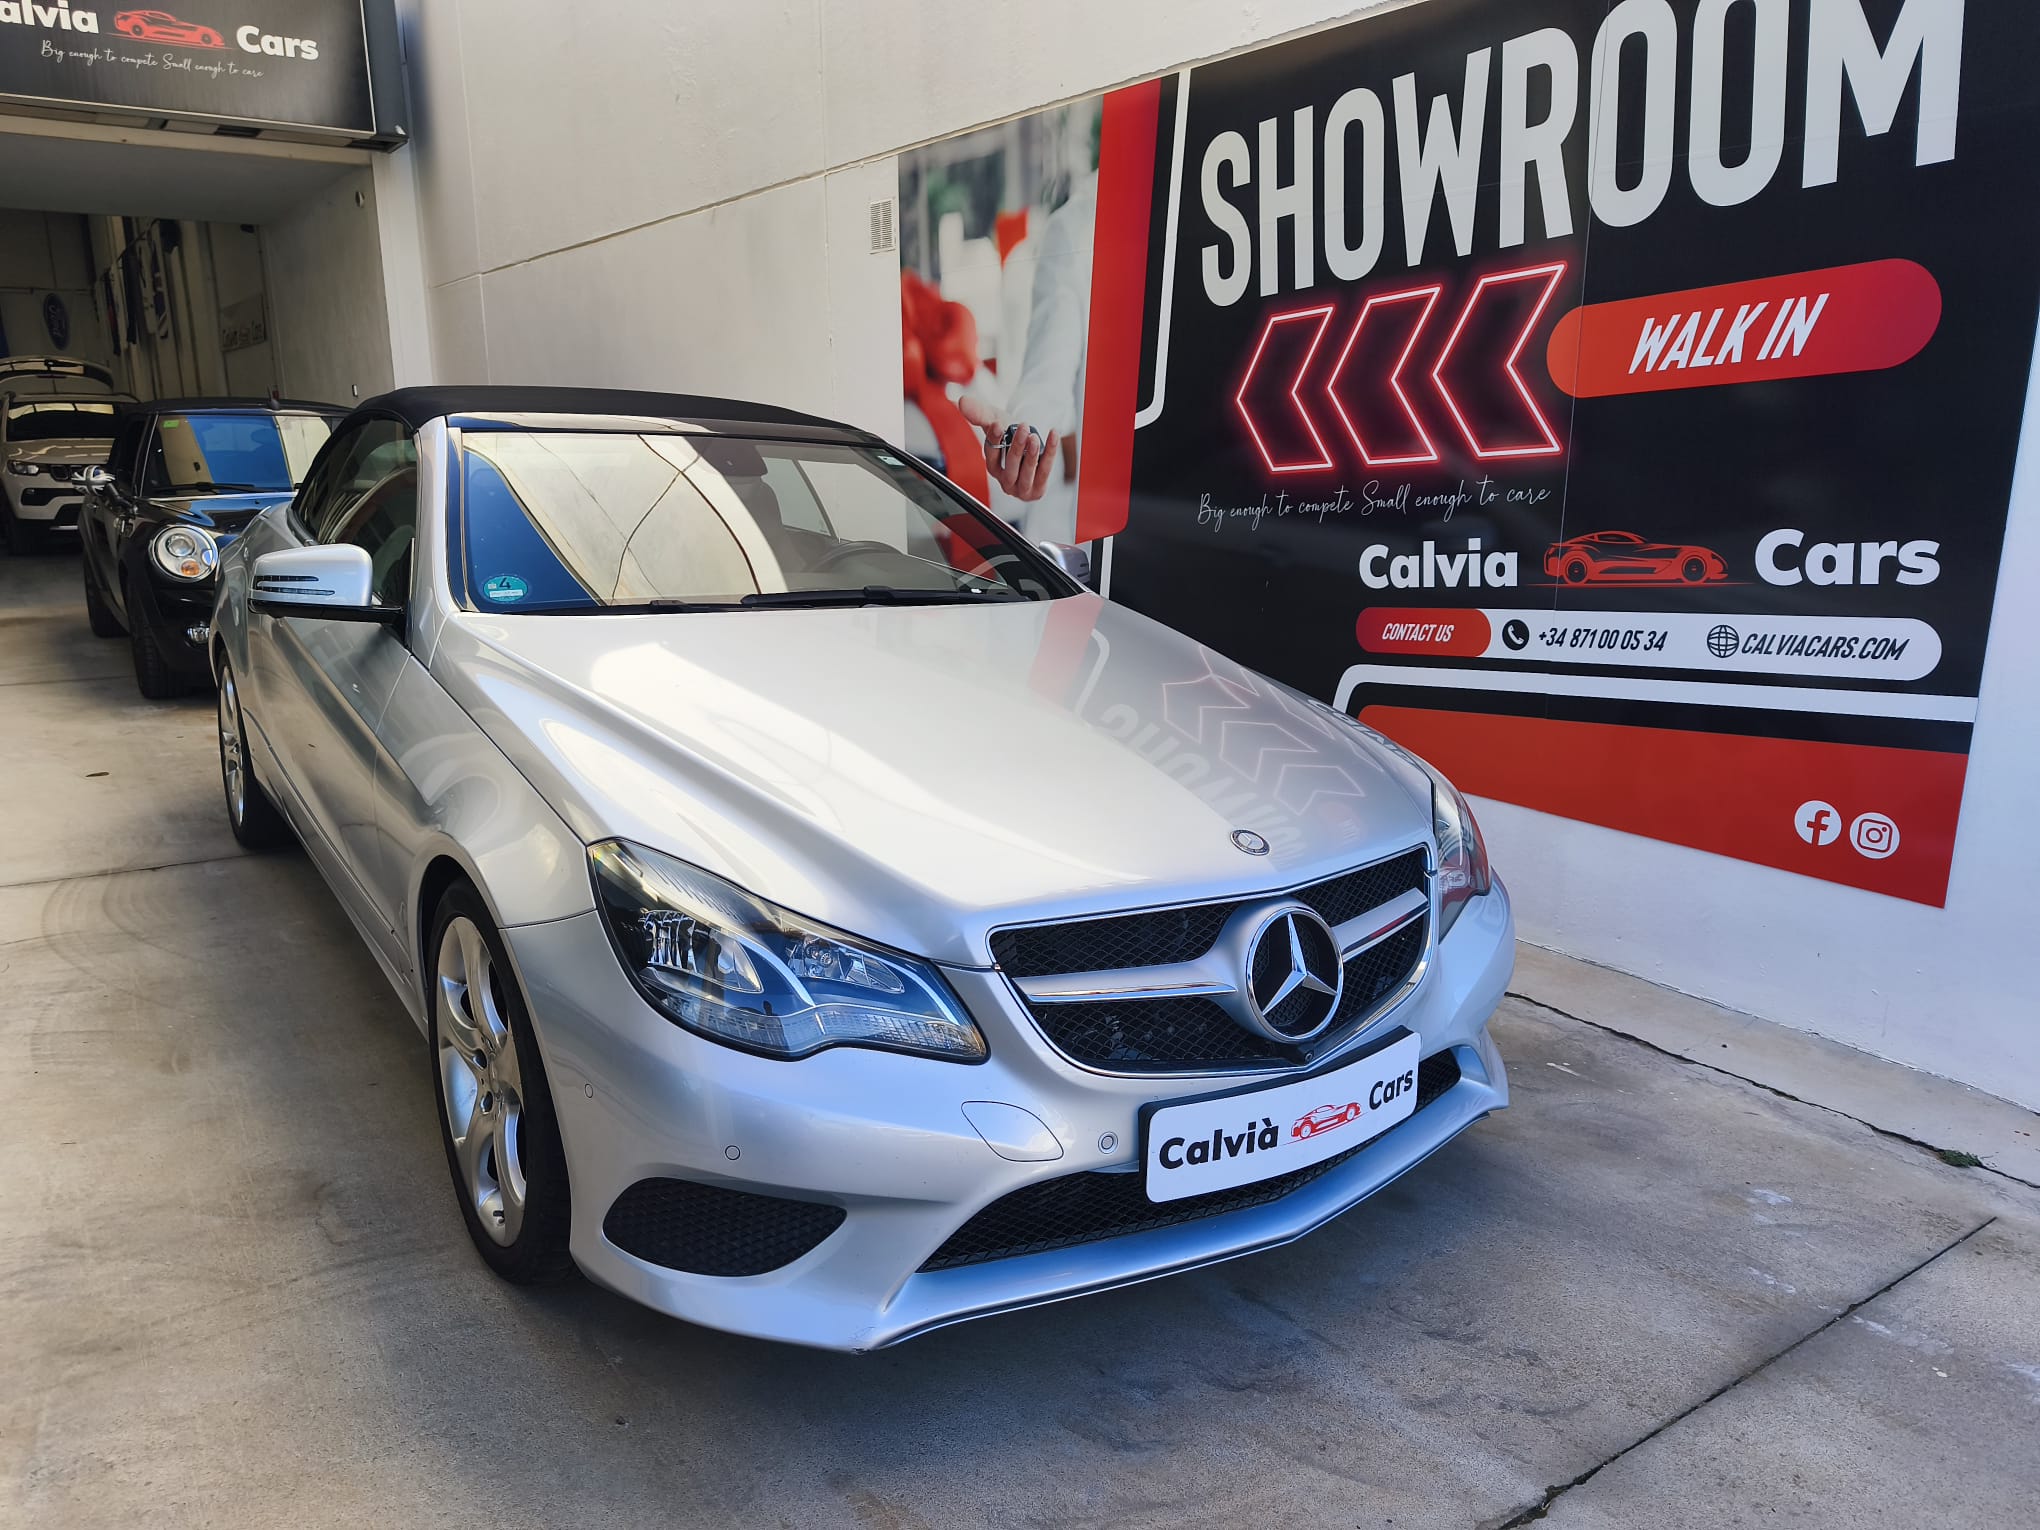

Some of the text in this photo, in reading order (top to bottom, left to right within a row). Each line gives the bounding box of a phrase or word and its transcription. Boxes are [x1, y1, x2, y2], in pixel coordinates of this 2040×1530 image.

[0, 0, 319, 60] alvia Cars
[41, 40, 264, 79] Big enough to compete Small enough to care
[1201, 0, 1966, 306] SHOWROOM
[1628, 293, 1830, 375] WALK IN
[1198, 474, 1551, 532] Big enough to compete Small enough to care
[1358, 528, 1941, 589] Calvia Cars
[1381, 623, 1455, 642] CONTACT US
[1538, 628, 1568, 647] +34
[1620, 630, 1643, 651] 05
[1643, 631, 1668, 651] 34
[1741, 633, 1910, 660] CALVIACARS.COM
[1159, 1069, 1413, 1170] Calvià Cars
